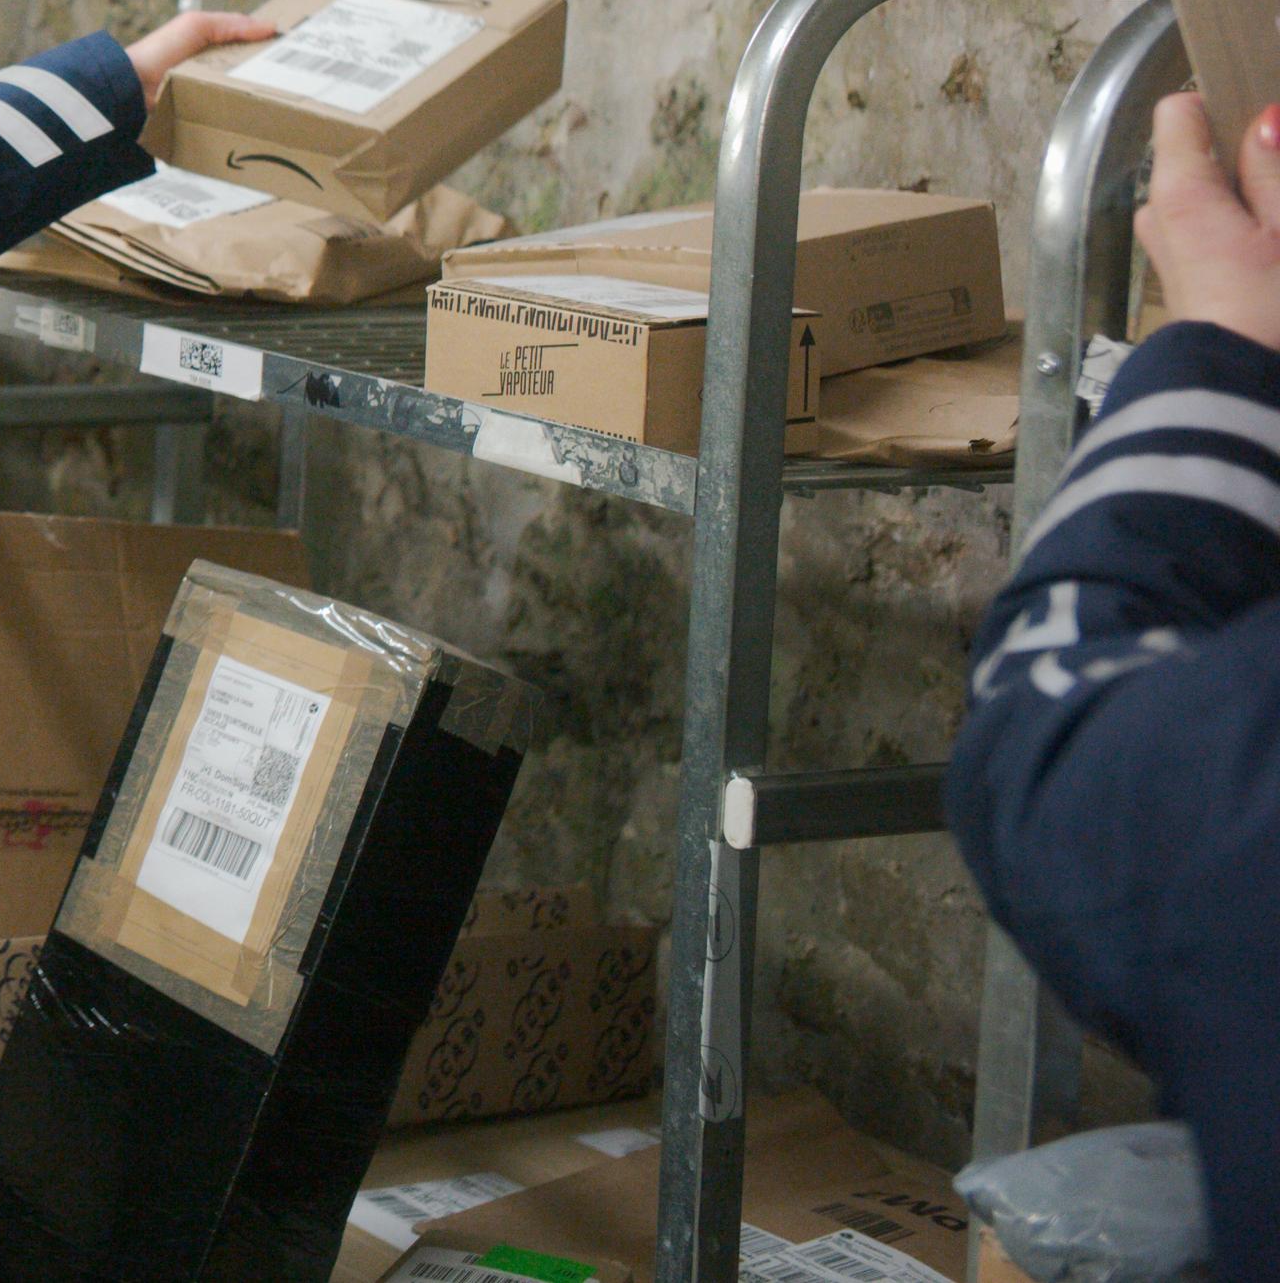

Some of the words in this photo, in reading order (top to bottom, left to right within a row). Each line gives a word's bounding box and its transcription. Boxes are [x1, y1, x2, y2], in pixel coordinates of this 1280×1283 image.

[500, 351, 511, 370] LE
[514, 345, 552, 371] PETIT
[499, 370, 555, 396] VAPOTEUR
